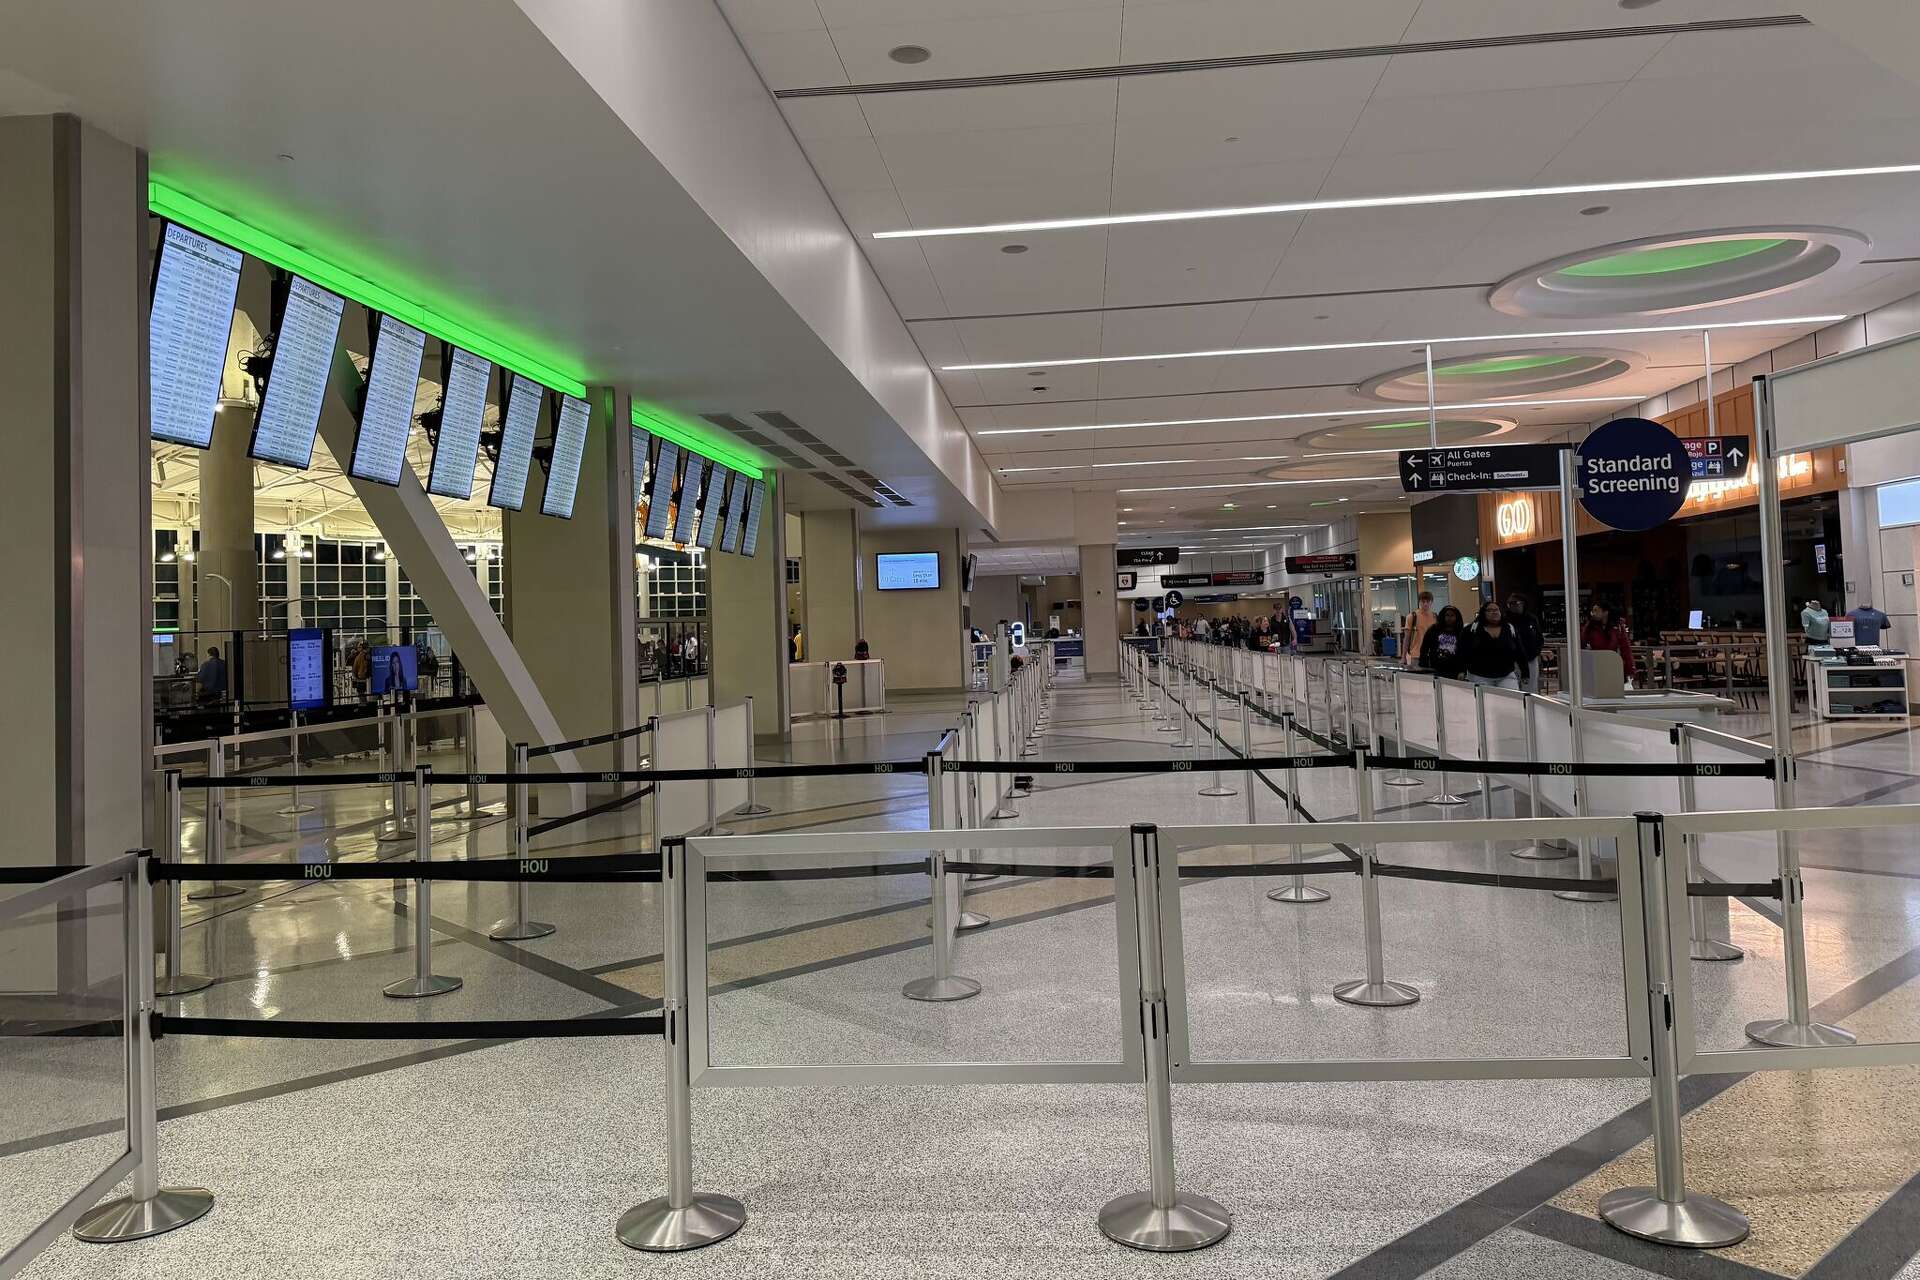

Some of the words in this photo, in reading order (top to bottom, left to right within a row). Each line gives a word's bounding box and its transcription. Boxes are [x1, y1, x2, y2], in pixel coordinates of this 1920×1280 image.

[167, 228, 208, 253] DEPARTURES
[1447, 451, 1460, 460] All
[1463, 450, 1492, 459] Gates
[1587, 453, 1672, 474] Standard
[1447, 471, 1492, 481] Check-In:
[1589, 474, 1680, 494] Screening
[943, 762, 960, 771] HOU
[1055, 763, 1074, 771] HOU
[1172, 761, 1192, 770] HOU
[1293, 758, 1313, 767] HOU
[1414, 759, 1435, 769] HOU
[874, 763, 893, 772] HOU
[1549, 764, 1572, 774] HOU
[1695, 765, 1721, 775] HOU
[379, 773, 396, 782] HOU
[602, 773, 619, 781] HOU
[736, 769, 754, 778] HOU
[251, 777, 268, 785] HOU
[470, 774, 487, 783] HOU
[519, 859, 549, 873] HOU
[304, 864, 332, 878] HOU
